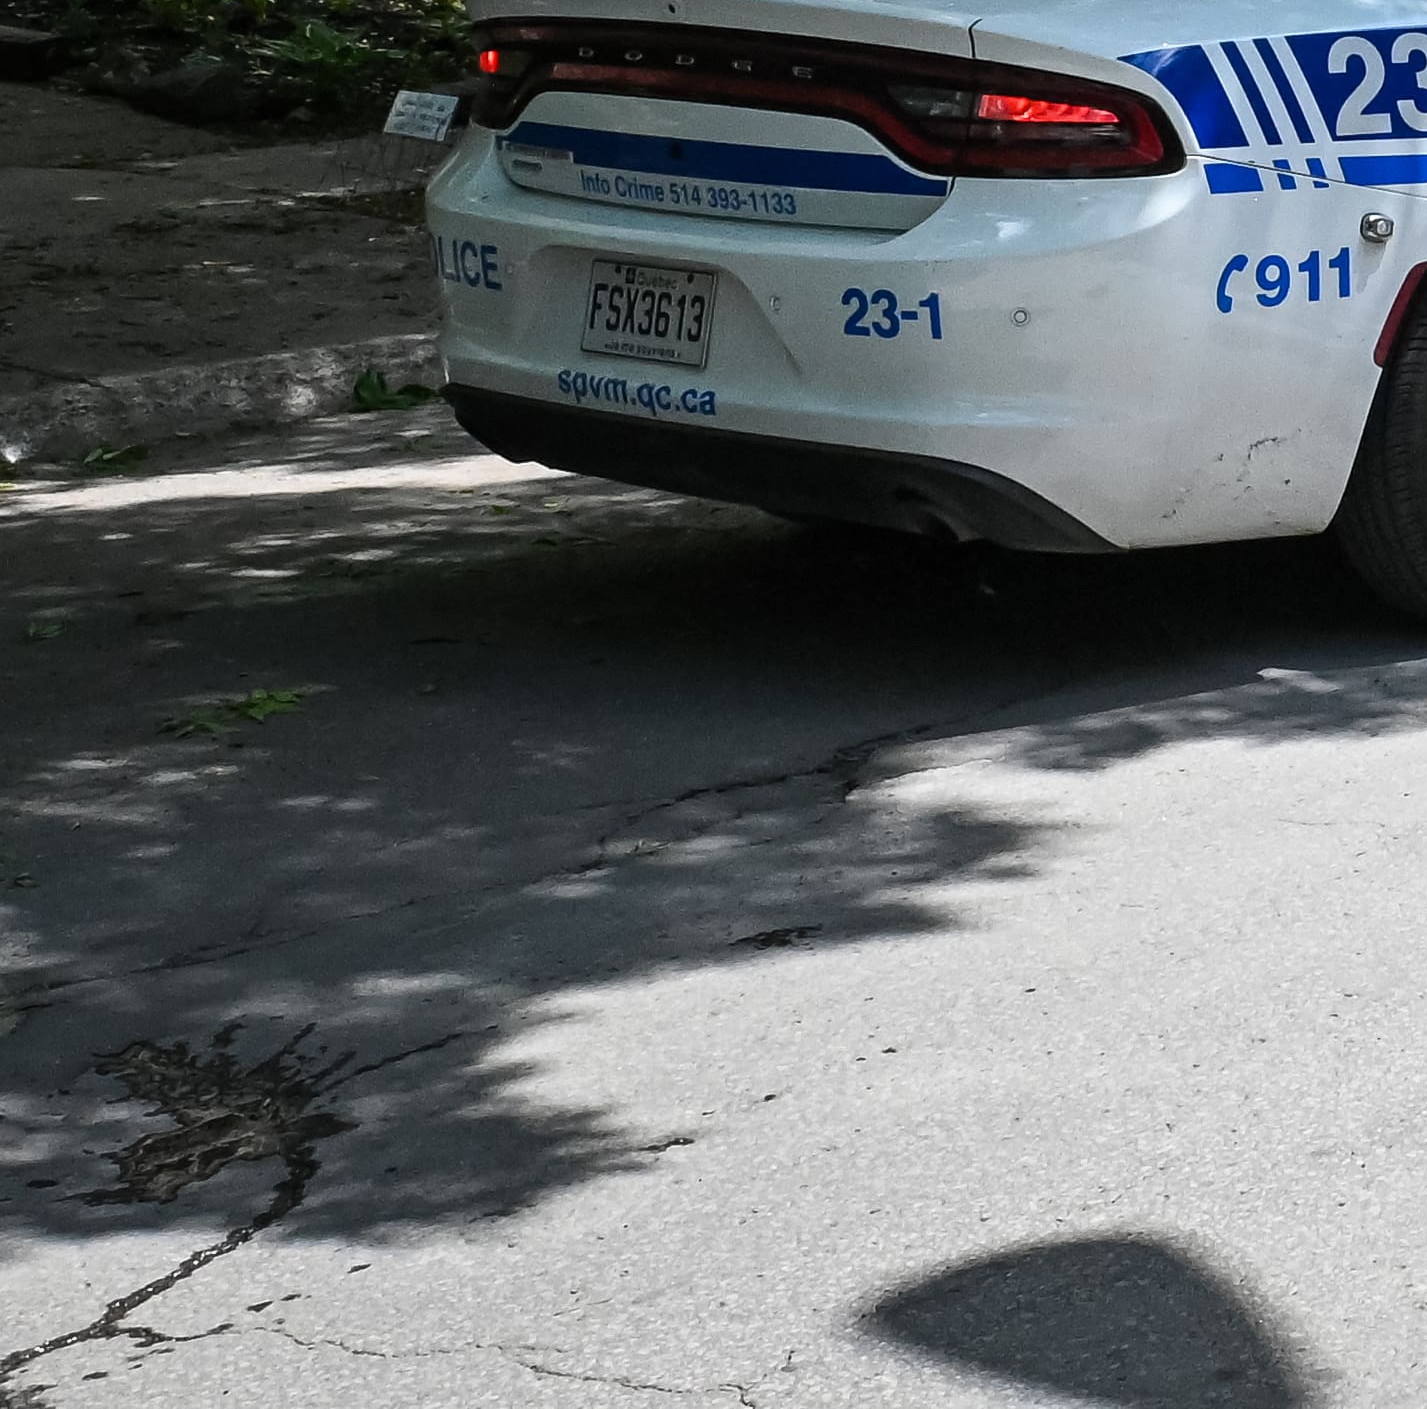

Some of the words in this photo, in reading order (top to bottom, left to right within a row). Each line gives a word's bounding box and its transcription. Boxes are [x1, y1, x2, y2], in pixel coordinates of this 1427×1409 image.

[580, 169, 610, 195] Info
[615, 176, 665, 203] Crime
[669, 183, 702, 206] 514
[708, 187, 797, 216] 393-1133
[430, 235, 502, 290] LICE
[1255, 246, 1351, 307] 911
[589, 282, 706, 342] FSX3613
[841, 287, 943, 340] 23-1
[558, 368, 718, 416] spvm.qc.ca
